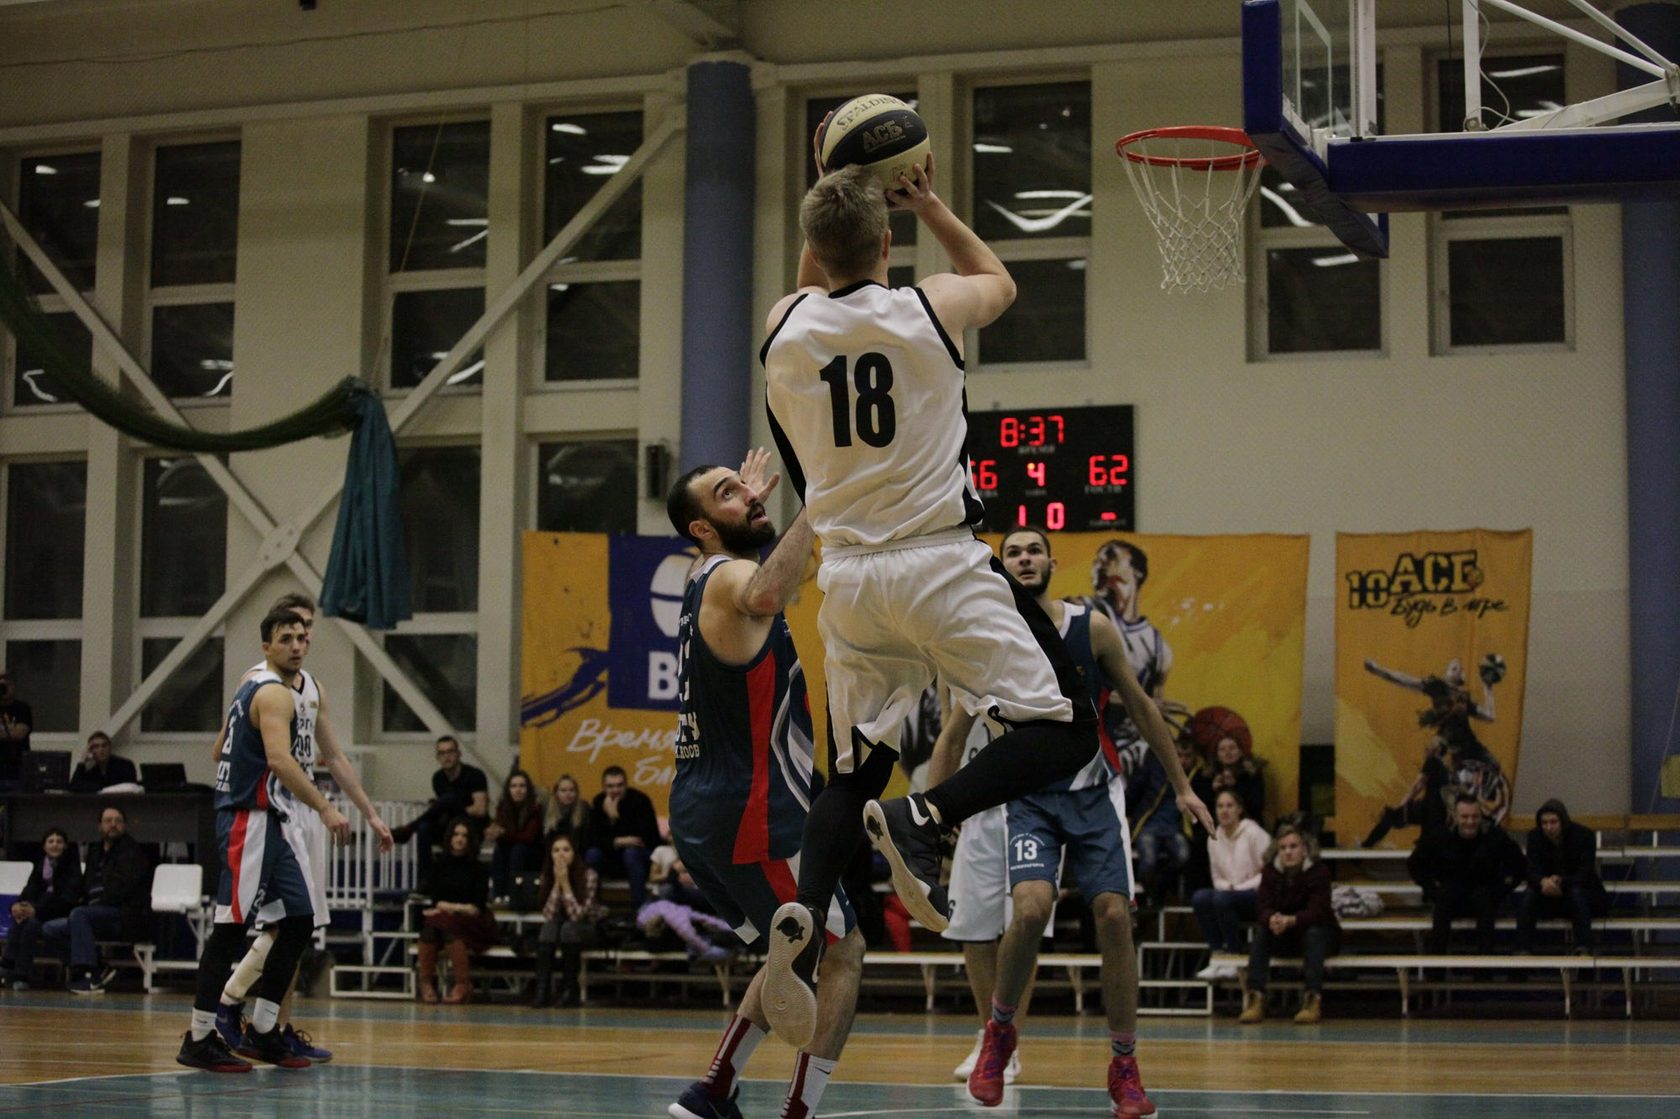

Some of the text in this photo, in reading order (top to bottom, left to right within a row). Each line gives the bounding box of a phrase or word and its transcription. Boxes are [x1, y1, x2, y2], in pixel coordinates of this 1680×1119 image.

[819, 352, 896, 447] 18
[999, 414, 1066, 448] 8:37
[1026, 461, 1046, 487] 4
[1088, 453, 1130, 486] 62
[1014, 839, 1038, 862] 13
